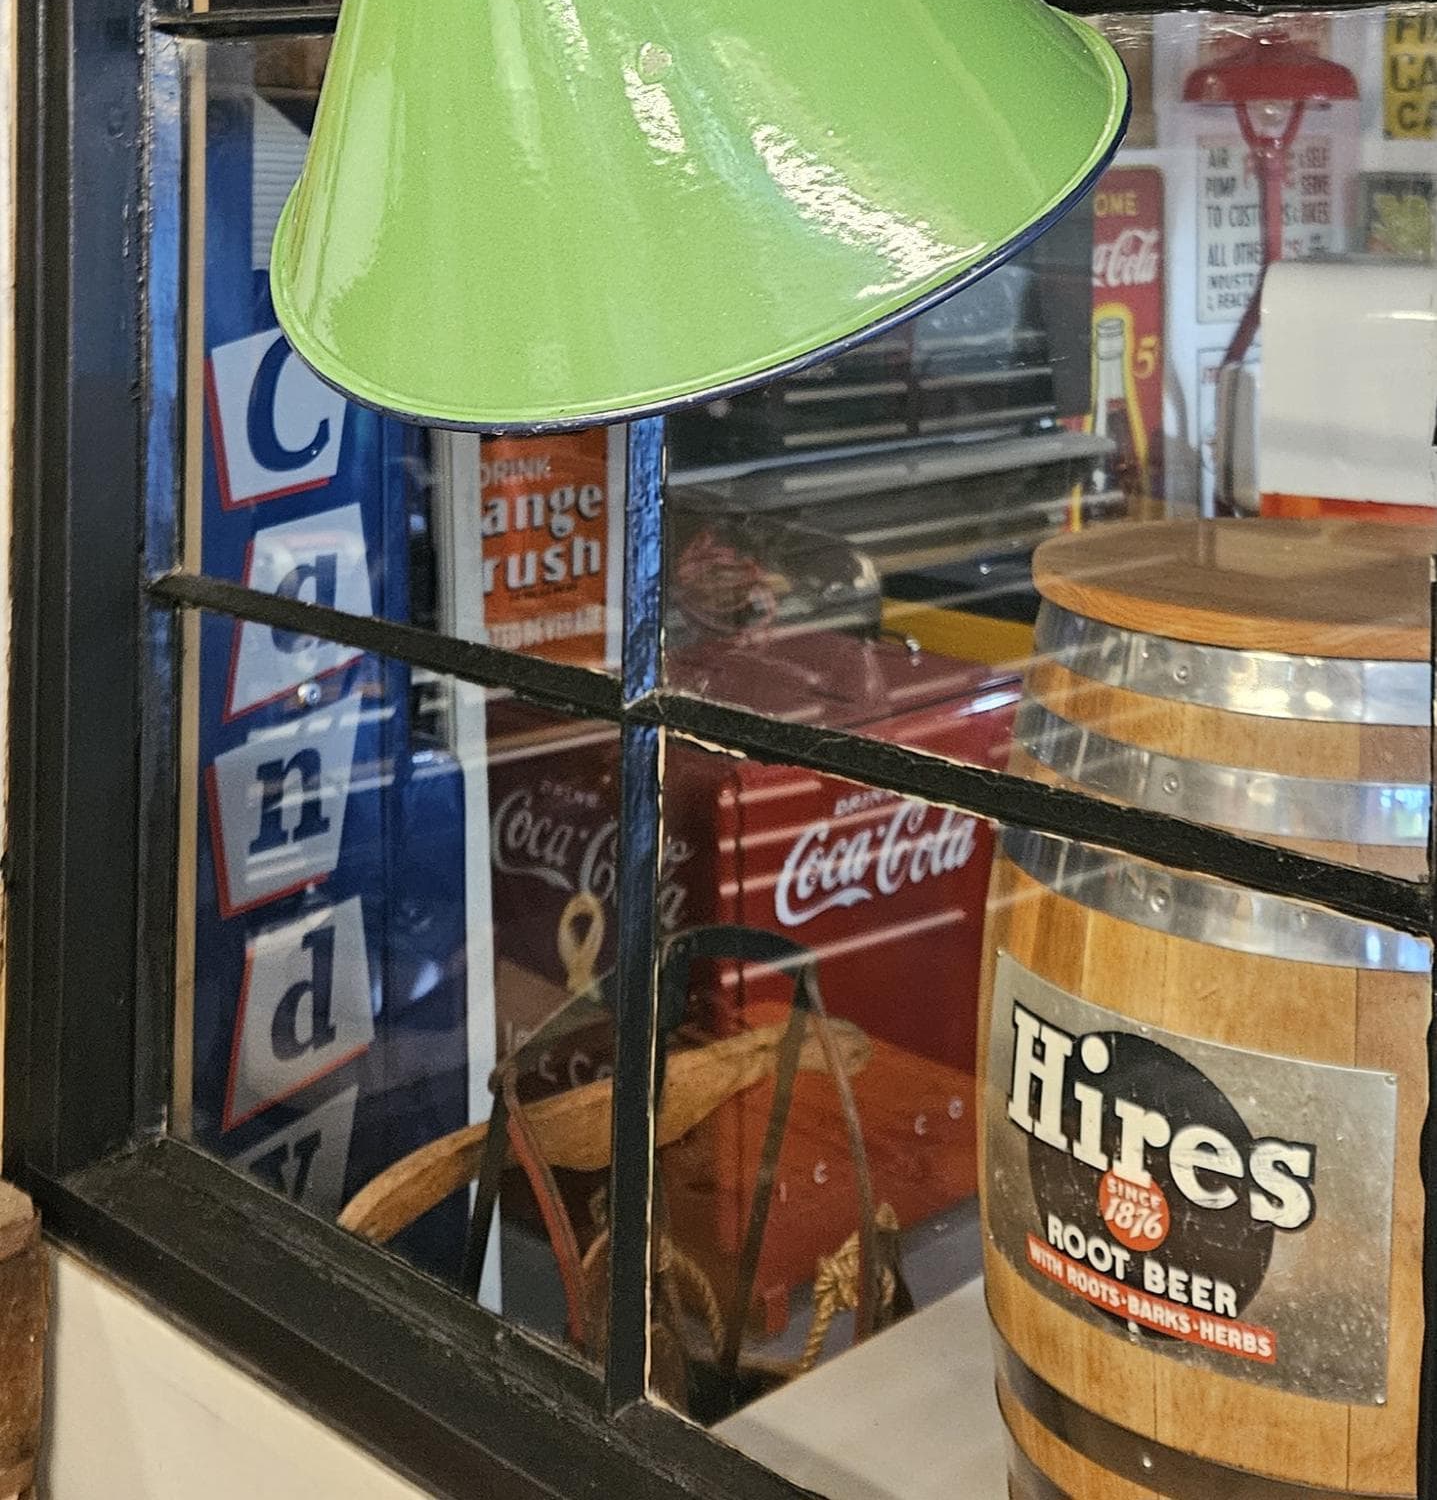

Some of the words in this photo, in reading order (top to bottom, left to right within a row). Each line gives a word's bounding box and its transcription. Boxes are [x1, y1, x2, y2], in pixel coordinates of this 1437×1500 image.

[1205, 176, 1237, 198] PUMP
[1206, 204, 1222, 228] TO
[1207, 242, 1226, 267] ALL
[1008, 1006, 1313, 1229] Hires
[1106, 1177, 1162, 1211] SINCE
[1105, 1198, 1164, 1240] 1876
[1028, 1240, 1063, 1280] WITH
[1047, 1213, 1131, 1280] ROOT
[1143, 1256, 1237, 1318] BEER
